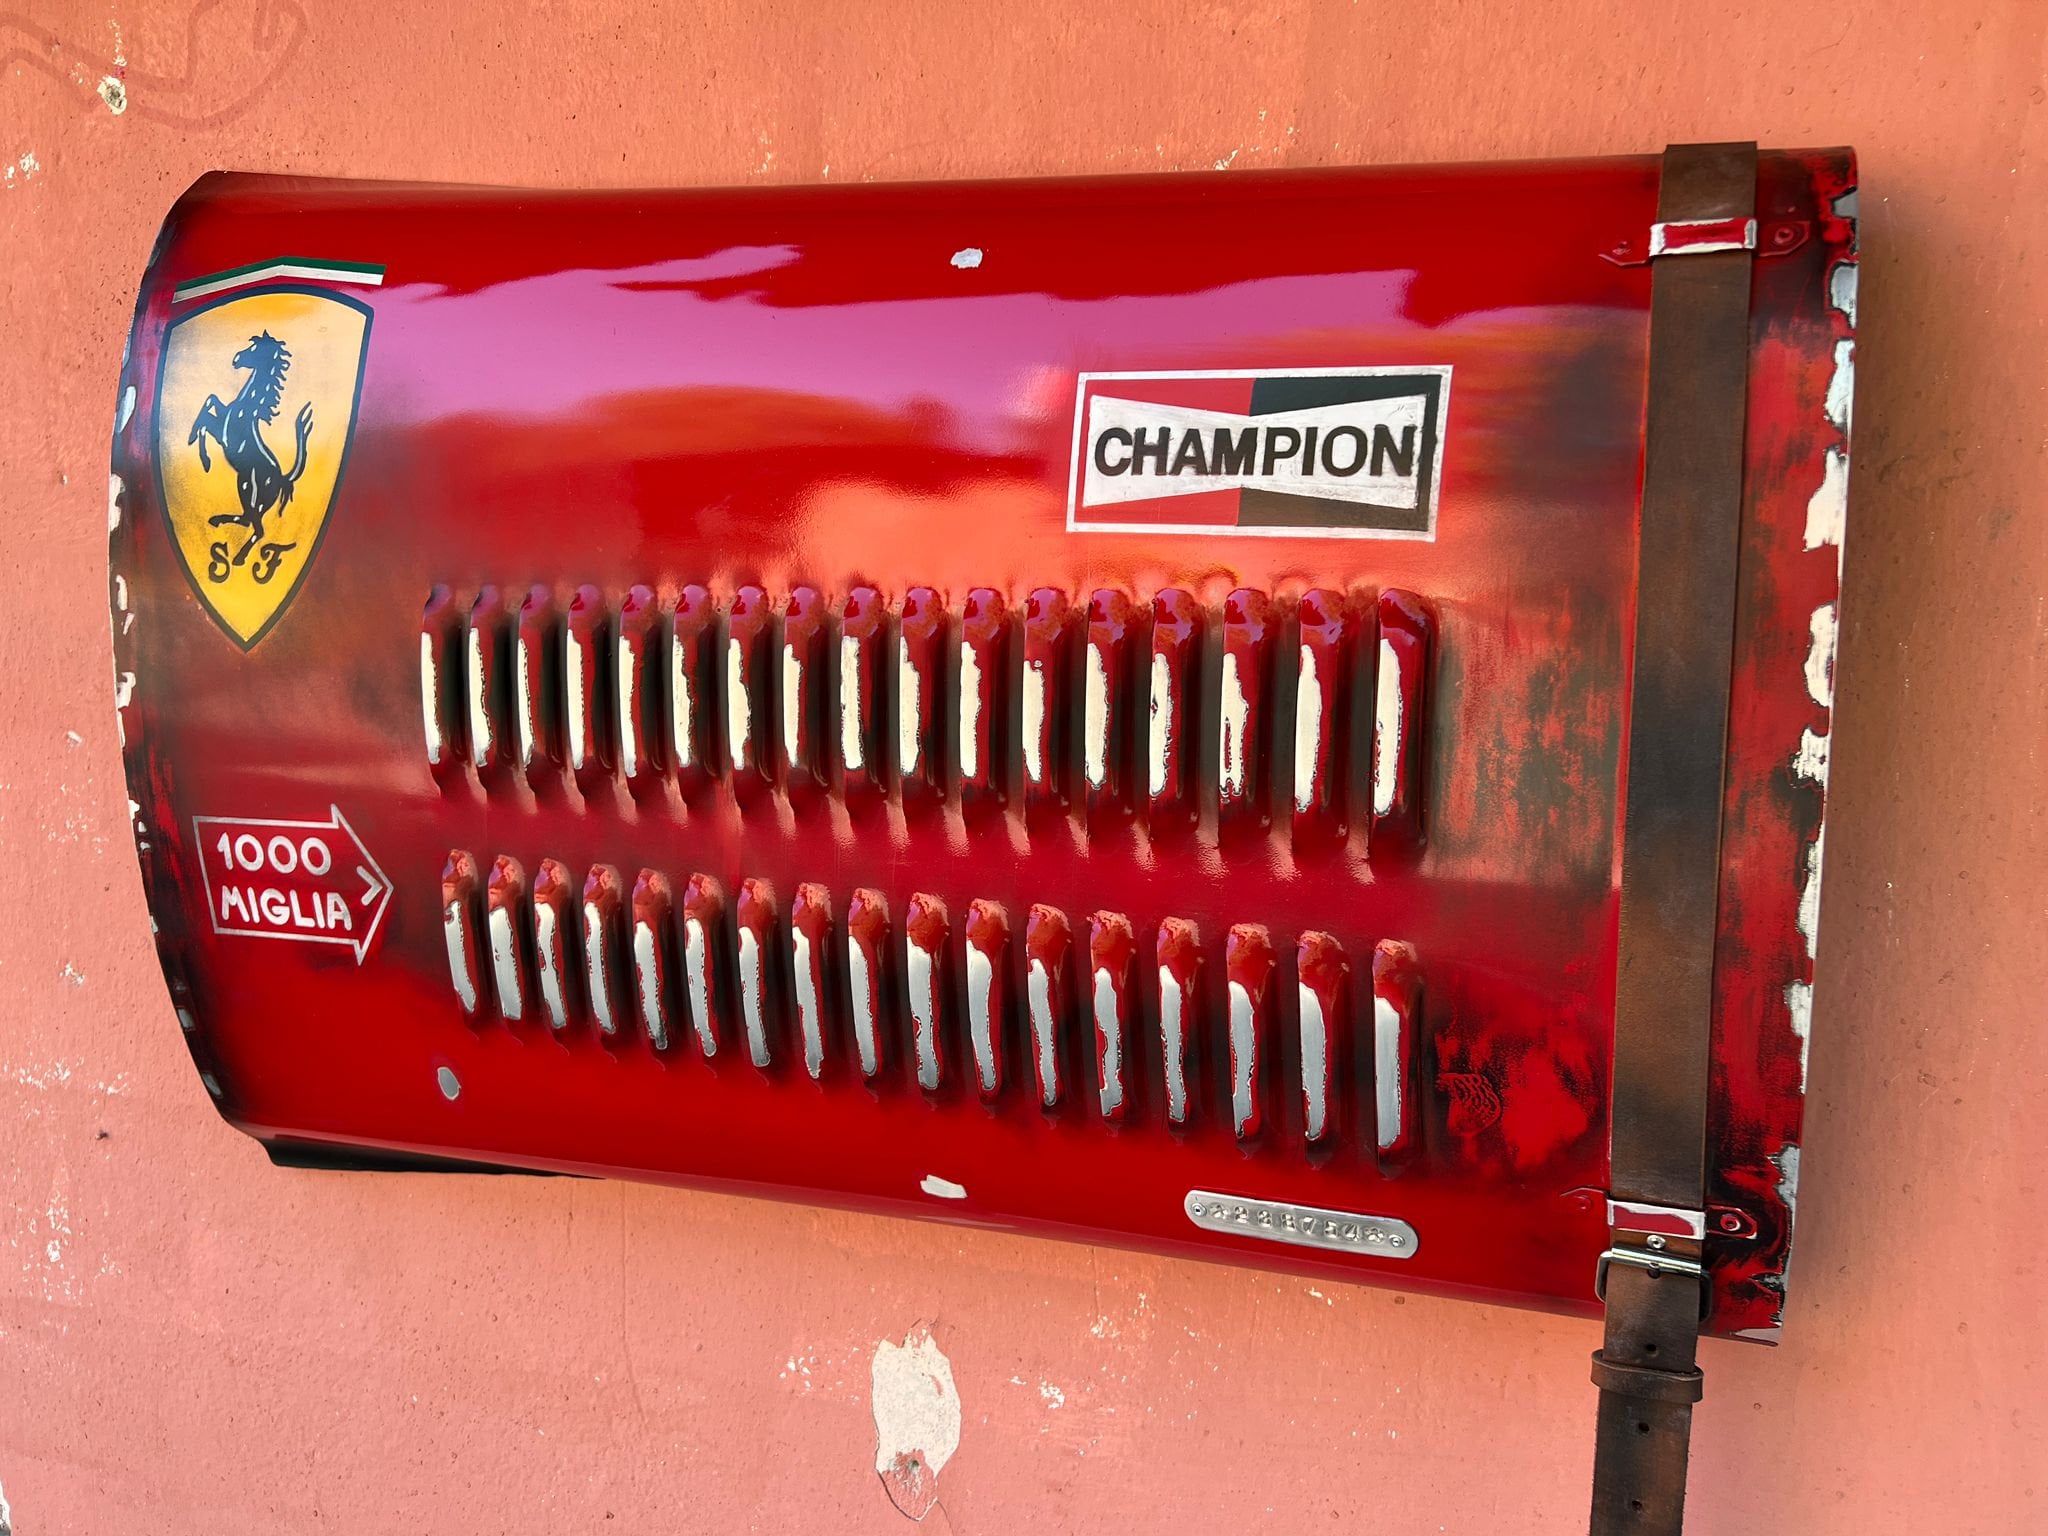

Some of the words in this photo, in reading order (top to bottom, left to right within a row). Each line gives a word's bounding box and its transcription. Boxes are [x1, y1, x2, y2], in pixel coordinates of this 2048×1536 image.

[1094, 424, 1416, 477] CHAMPION
[217, 832, 331, 876] 1000
[221, 885, 352, 931] MIGLIA
